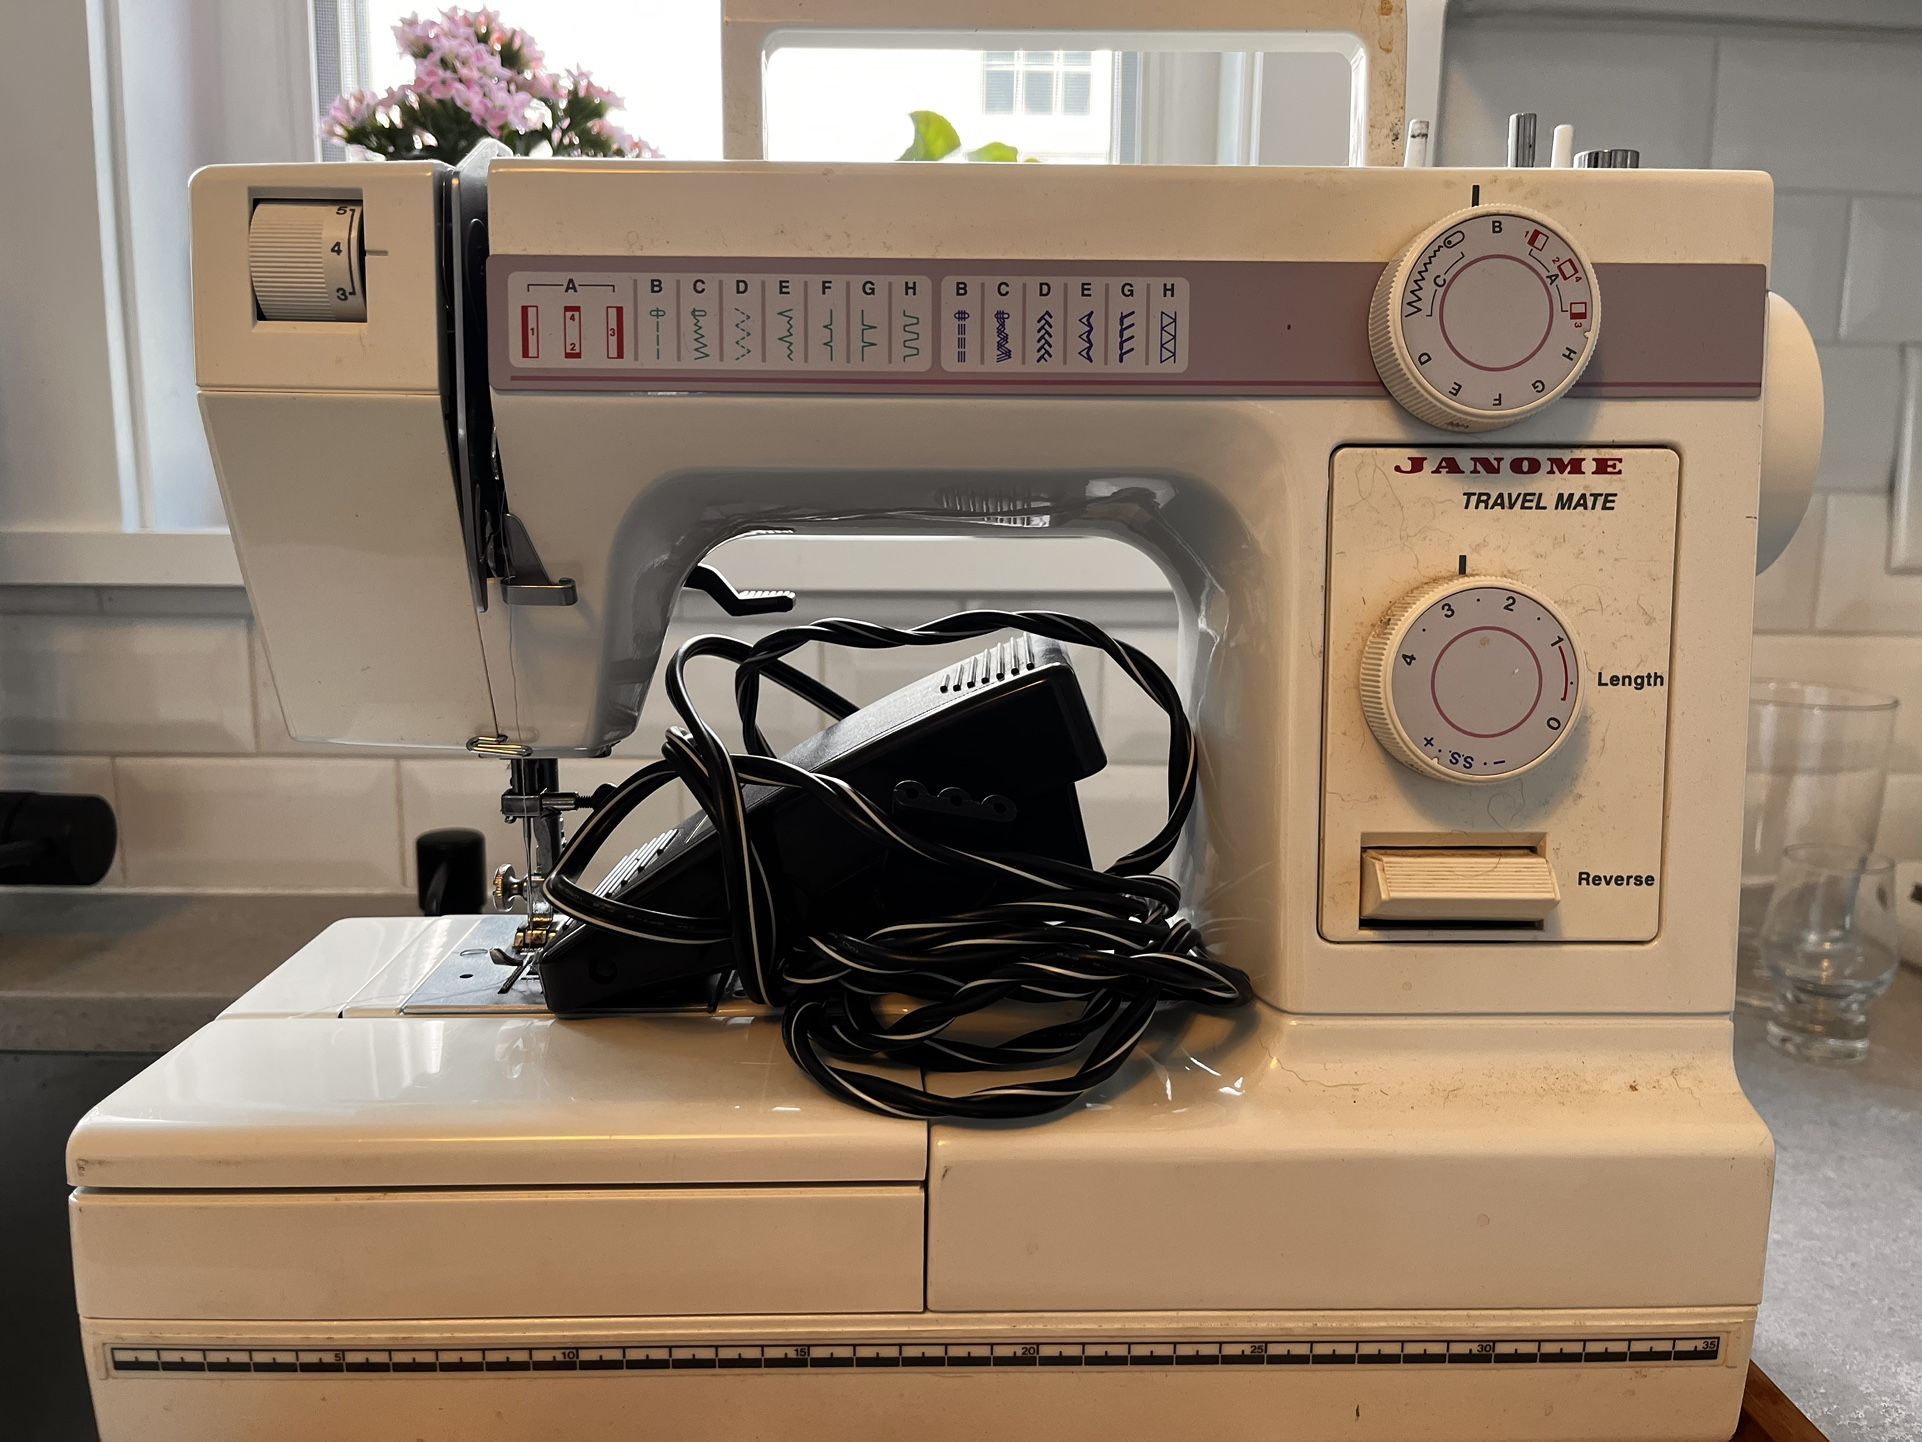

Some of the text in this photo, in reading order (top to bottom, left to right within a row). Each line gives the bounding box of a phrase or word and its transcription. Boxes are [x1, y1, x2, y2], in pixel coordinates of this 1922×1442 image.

[336, 206, 348, 215] 5
[1491, 220, 1503, 234] B
[1523, 230, 1530, 239] 1
[331, 241, 343, 256] 4
[1551, 256, 1560, 265] 2
[1433, 274, 1447, 288] C
[1545, 272, 1560, 286] A
[1574, 275, 1583, 283] 4
[564, 278, 917, 296] A B C D E F G H
[956, 282, 1175, 297] B C D E G H
[336, 287, 349, 302] 3
[569, 313, 576, 322] 4
[529, 327, 535, 337] 1
[609, 327, 616, 337] 3
[569, 342, 576, 352] 2
[1562, 346, 1578, 361] H
[1417, 352, 1432, 366] D
[1448, 382, 1462, 396] E
[1531, 379, 1546, 393] G
[1492, 393, 1502, 406] F
[1393, 456, 1623, 475] JANOME
[1462, 491, 1618, 511] TRAVEL MATE
[1441, 602, 1455, 618] 3
[1503, 595, 1517, 612] 2
[1550, 635, 1564, 647] 1
[1401, 653, 1416, 666] 4
[1597, 671, 1664, 691] Length
[1546, 717, 1561, 731] 0
[1578, 871, 1655, 887] Reverse
[334, 1341, 1716, 1361] 5 10 15 20 25 30 35
